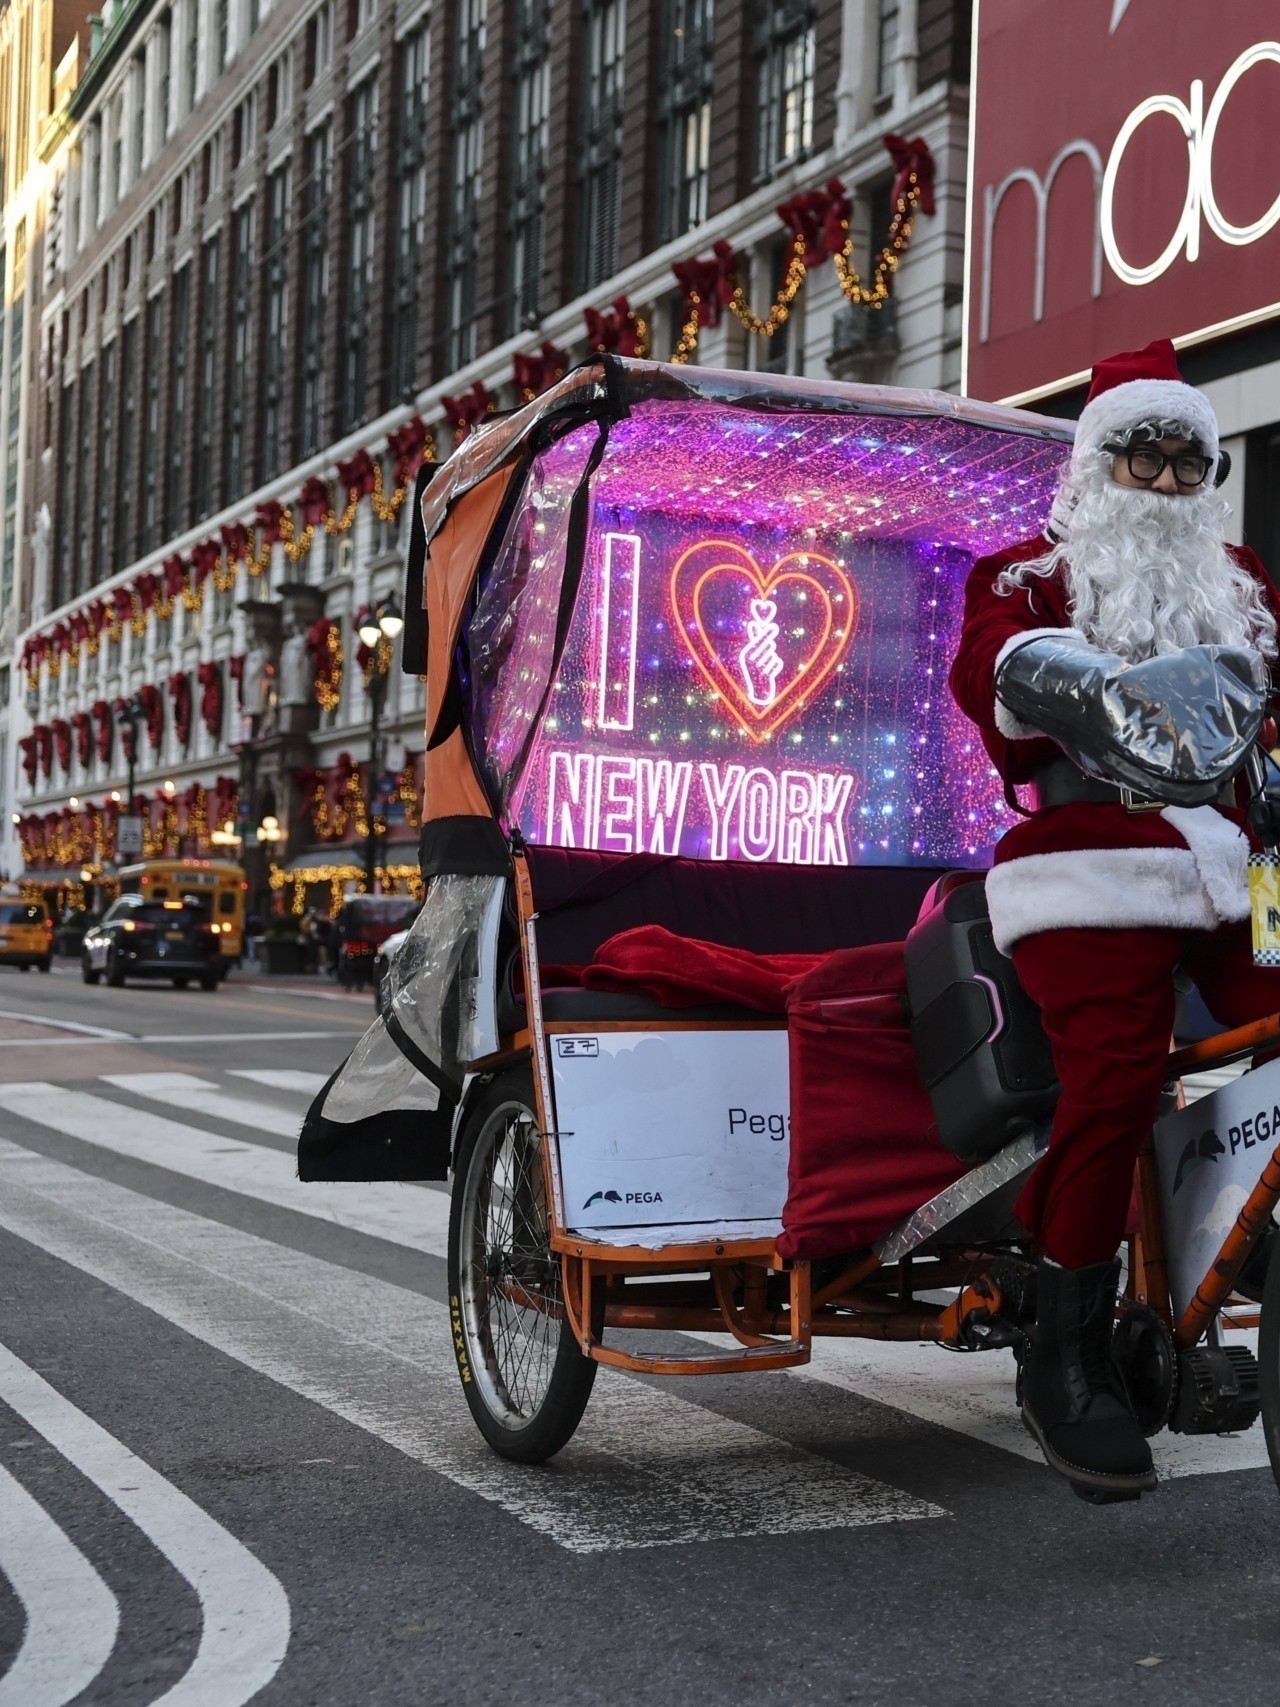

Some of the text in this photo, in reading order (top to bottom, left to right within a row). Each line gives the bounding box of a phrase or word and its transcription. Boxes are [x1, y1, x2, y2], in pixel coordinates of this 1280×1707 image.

[600, 532, 641, 731] I
[546, 751, 854, 866] NEW YORK
[729, 1108, 791, 1141] Peg
[625, 1192, 663, 1204] PEGA
[451, 1296, 471, 1383] MAXXIS
